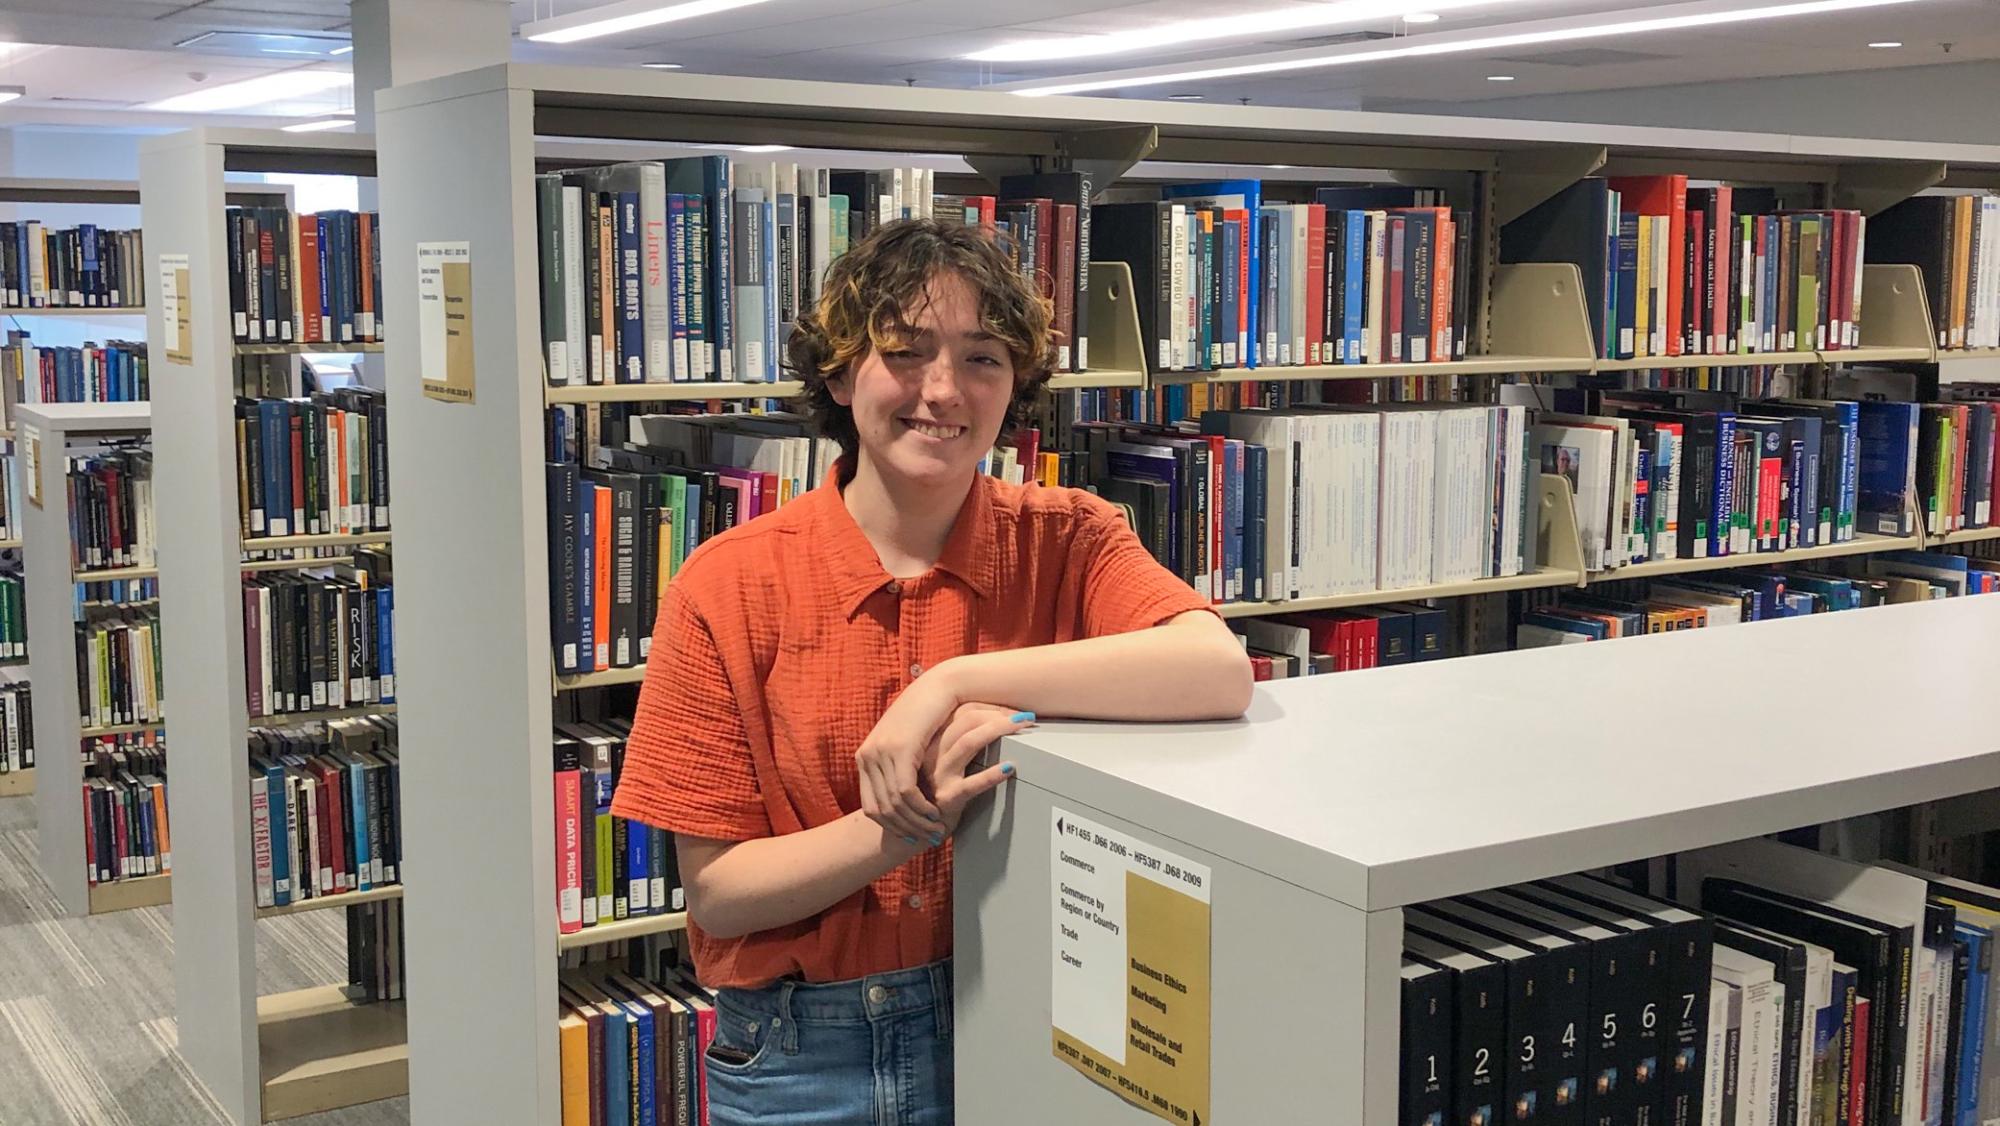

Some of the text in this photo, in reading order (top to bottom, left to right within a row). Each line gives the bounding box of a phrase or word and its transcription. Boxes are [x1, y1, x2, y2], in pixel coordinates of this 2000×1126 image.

[647, 221, 664, 287] Liners
[1080, 217, 1091, 292] NORTHWESTERN
[1174, 225, 1183, 306] CABLE COWBOY
[624, 249, 639, 321] BOX BOATS
[1848, 421, 1858, 464] BUSINESS
[1718, 423, 1729, 525] BUSINESS DICTIONAR
[1724, 430, 1735, 522] FRENCH ENGLISH
[1792, 487, 1800, 518] Spanish
[564, 514, 573, 533] JAY
[618, 516, 632, 545] SUGAR
[1197, 543, 1205, 577] INDUSTR
[617, 556, 632, 604] RAILROADS
[351, 608, 361, 668] RISK
[253, 792, 268, 811] THE
[255, 829, 270, 870] FACTOR
[566, 780, 576, 889] SMART DATA PRICIN
[1060, 851, 1095, 874] Commerce
[1066, 823, 1091, 842] HF1455
[1093, 834, 1108, 849] .D66
[1109, 841, 1127, 857] 2006
[1134, 850, 1161, 871] HF5387
[1162, 863, 1181, 879] .D68
[1183, 870, 1202, 888] 2009
[1060, 882, 1105, 913] Commerce by
[1060, 898, 1120, 936] Region or Country
[1060, 923, 1079, 941] Trade
[1061, 950, 1082, 969] Career
[1131, 957, 1188, 994] Business Ethics
[1131, 984, 1167, 1014] Marketing
[1682, 994, 1695, 1019] 7
[1844, 986, 1856, 1023] Dealing
[1602, 1013, 1616, 1039] 5
[1642, 1003, 1656, 1029] 6
[1129, 1034, 1176, 1068] Retail Trades
[1130, 1017, 1183, 1054] Wholesale and
[1520, 1035, 1535, 1062] 3
[1561, 1023, 1576, 1048] 4
[1844, 1025, 1853, 1047] with
[1427, 1055, 1438, 1083] 1
[1474, 1048, 1489, 1076] 2
[1843, 1048, 1852, 1066] the
[677, 1040, 687, 1126] POWERFUL FREQU
[1840, 1067, 1851, 1095] Tough
